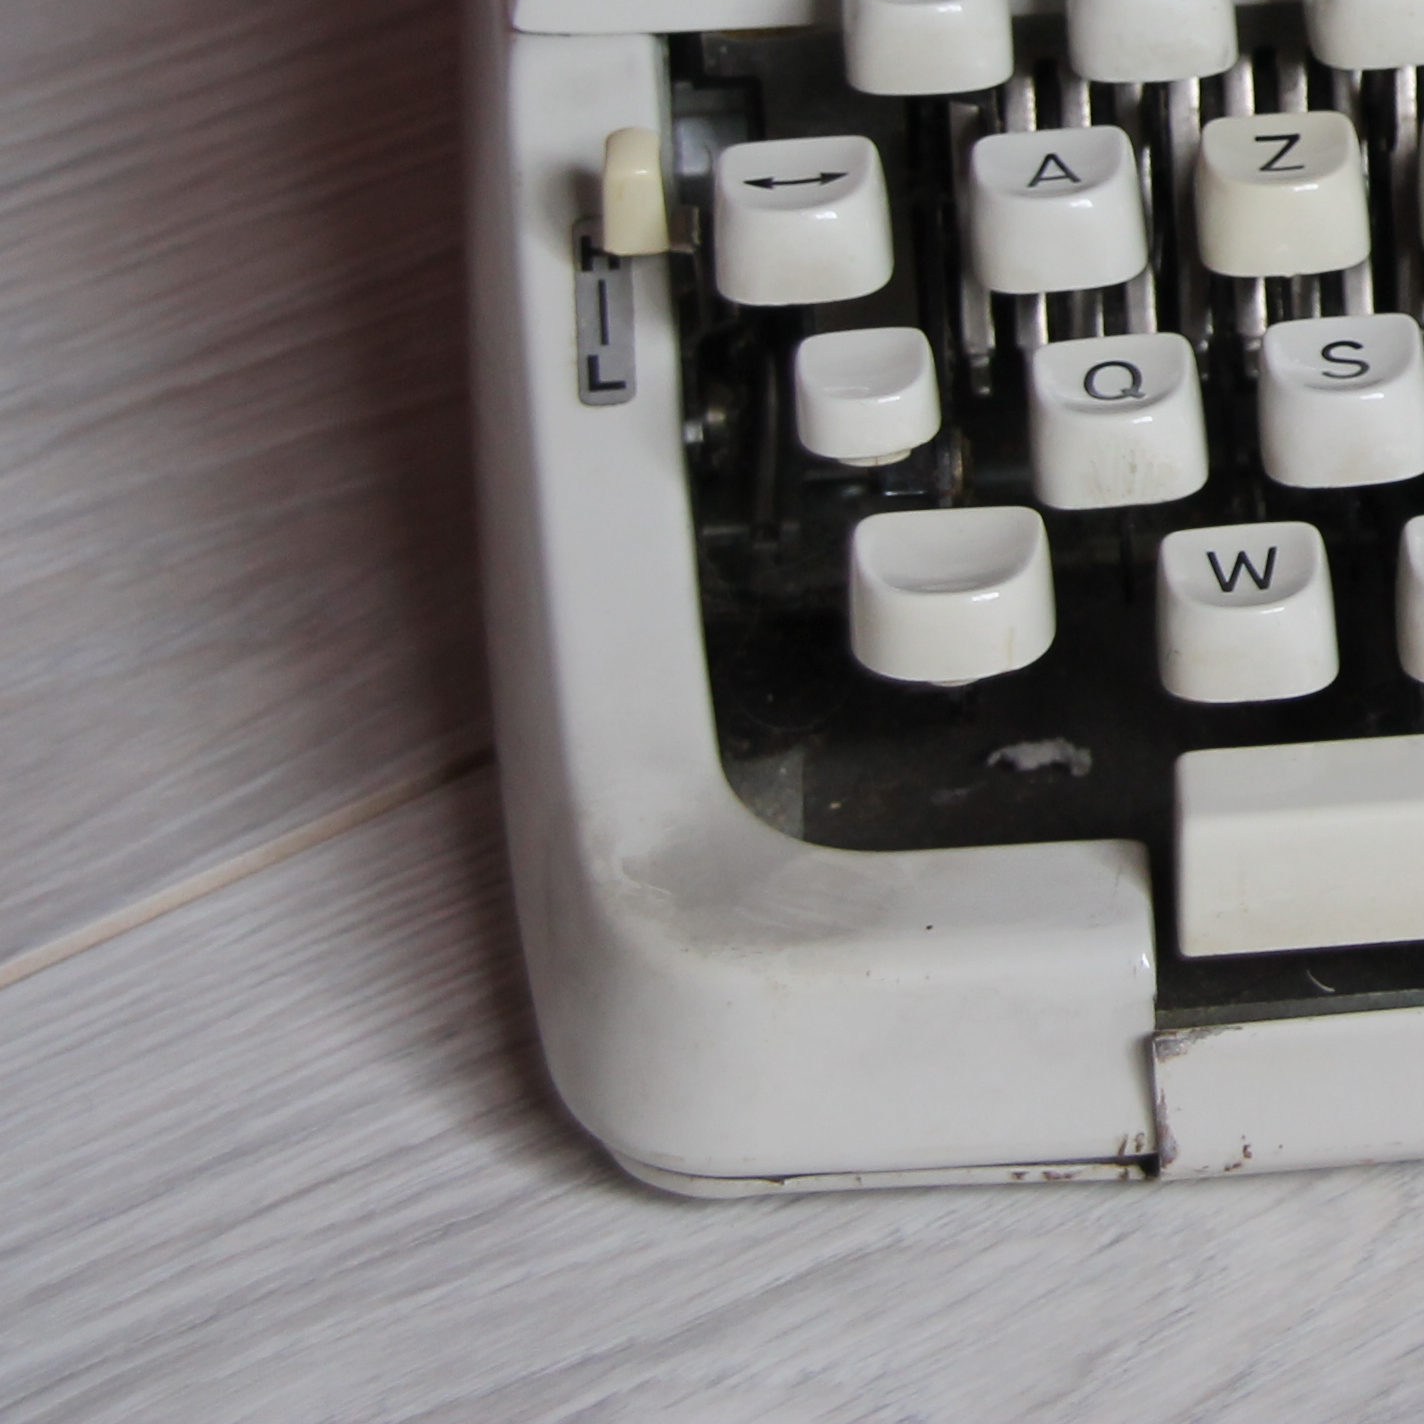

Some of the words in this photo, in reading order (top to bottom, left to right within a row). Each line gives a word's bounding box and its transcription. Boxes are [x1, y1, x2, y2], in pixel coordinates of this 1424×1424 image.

[1027, 153, 1081, 187] A
[1254, 133, 1305, 171] Z
[1321, 340, 1371, 379] S
[1083, 359, 1146, 402] Q
[1206, 545, 1277, 594] W
